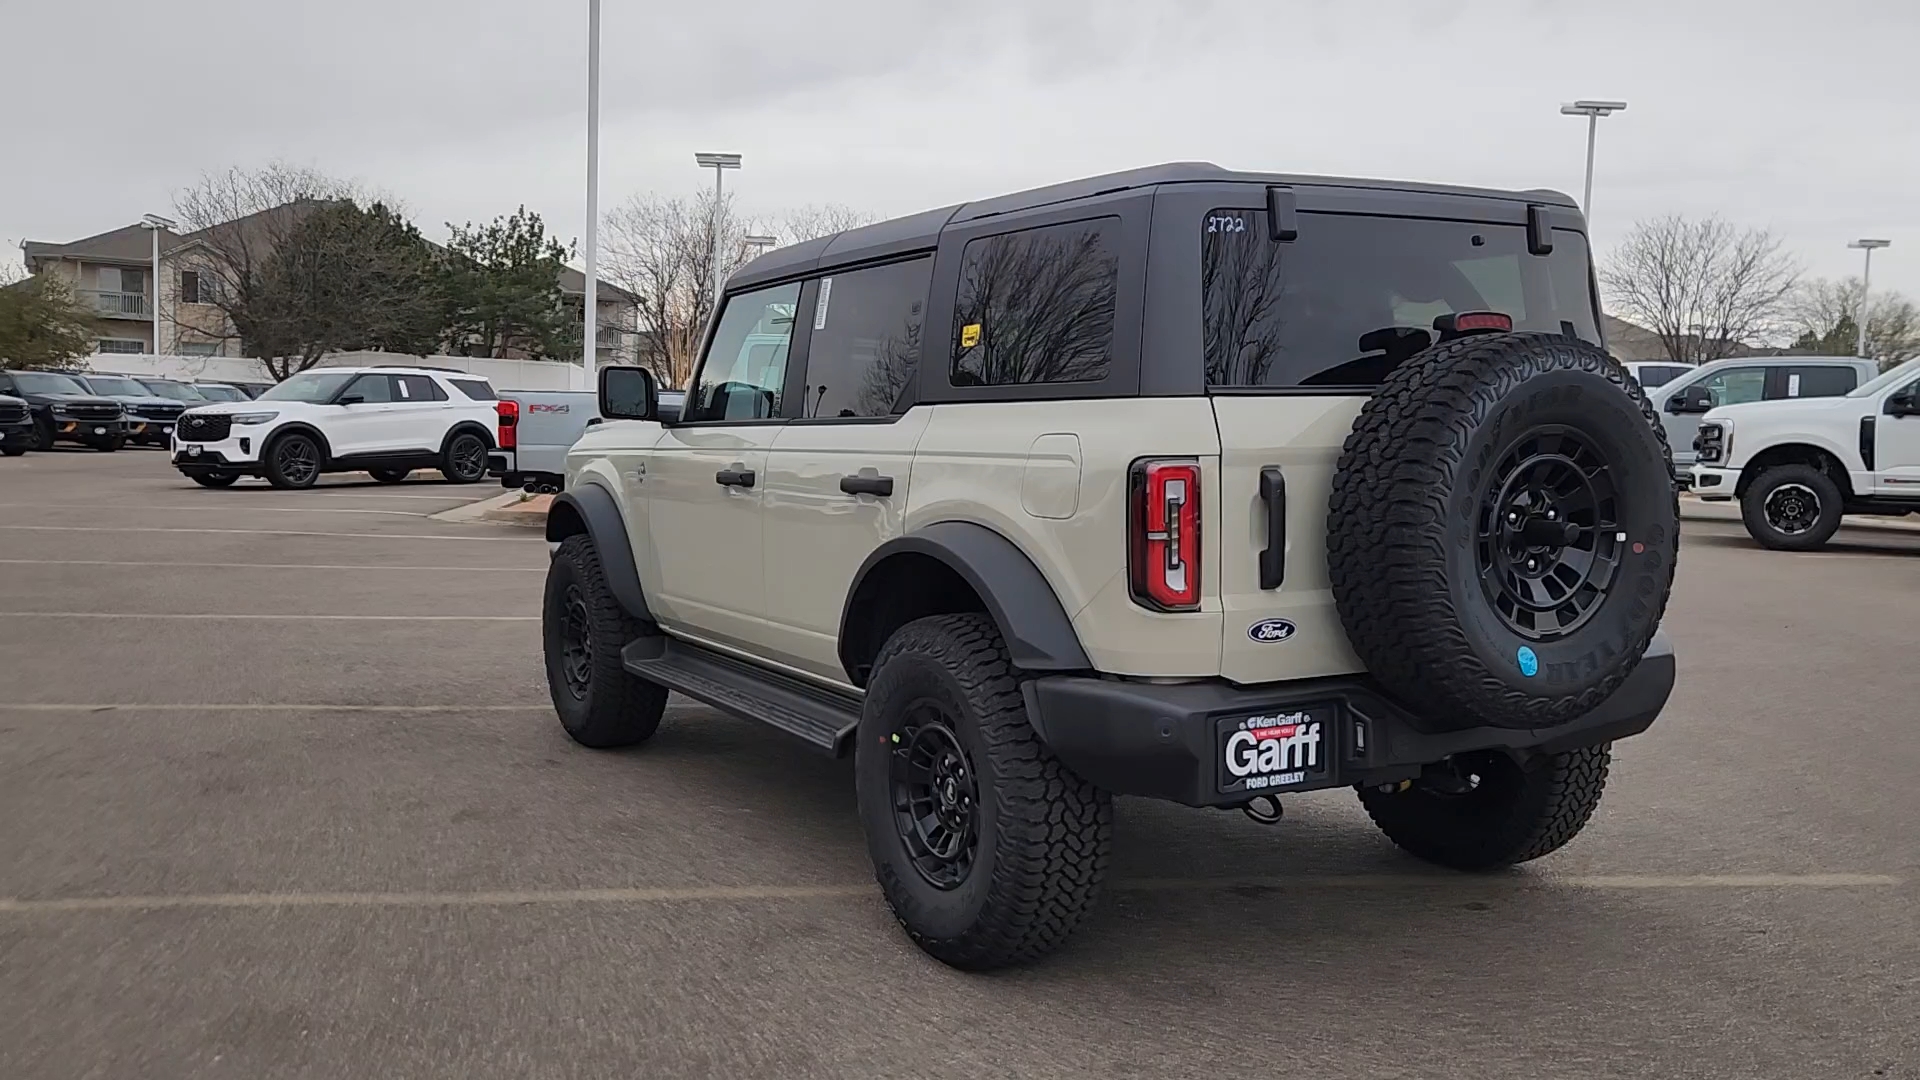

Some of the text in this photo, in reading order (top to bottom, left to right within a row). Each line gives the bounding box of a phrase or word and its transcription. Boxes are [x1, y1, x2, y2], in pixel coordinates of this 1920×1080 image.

[1208, 216, 1244, 233] 2722
[528, 404, 570, 414] FX4
[1258, 623, 1289, 639] Ford
[1256, 712, 1303, 728] Ken Garff
[1225, 723, 1320, 776] Garff
[1246, 771, 1305, 789] FORD GREELEY
